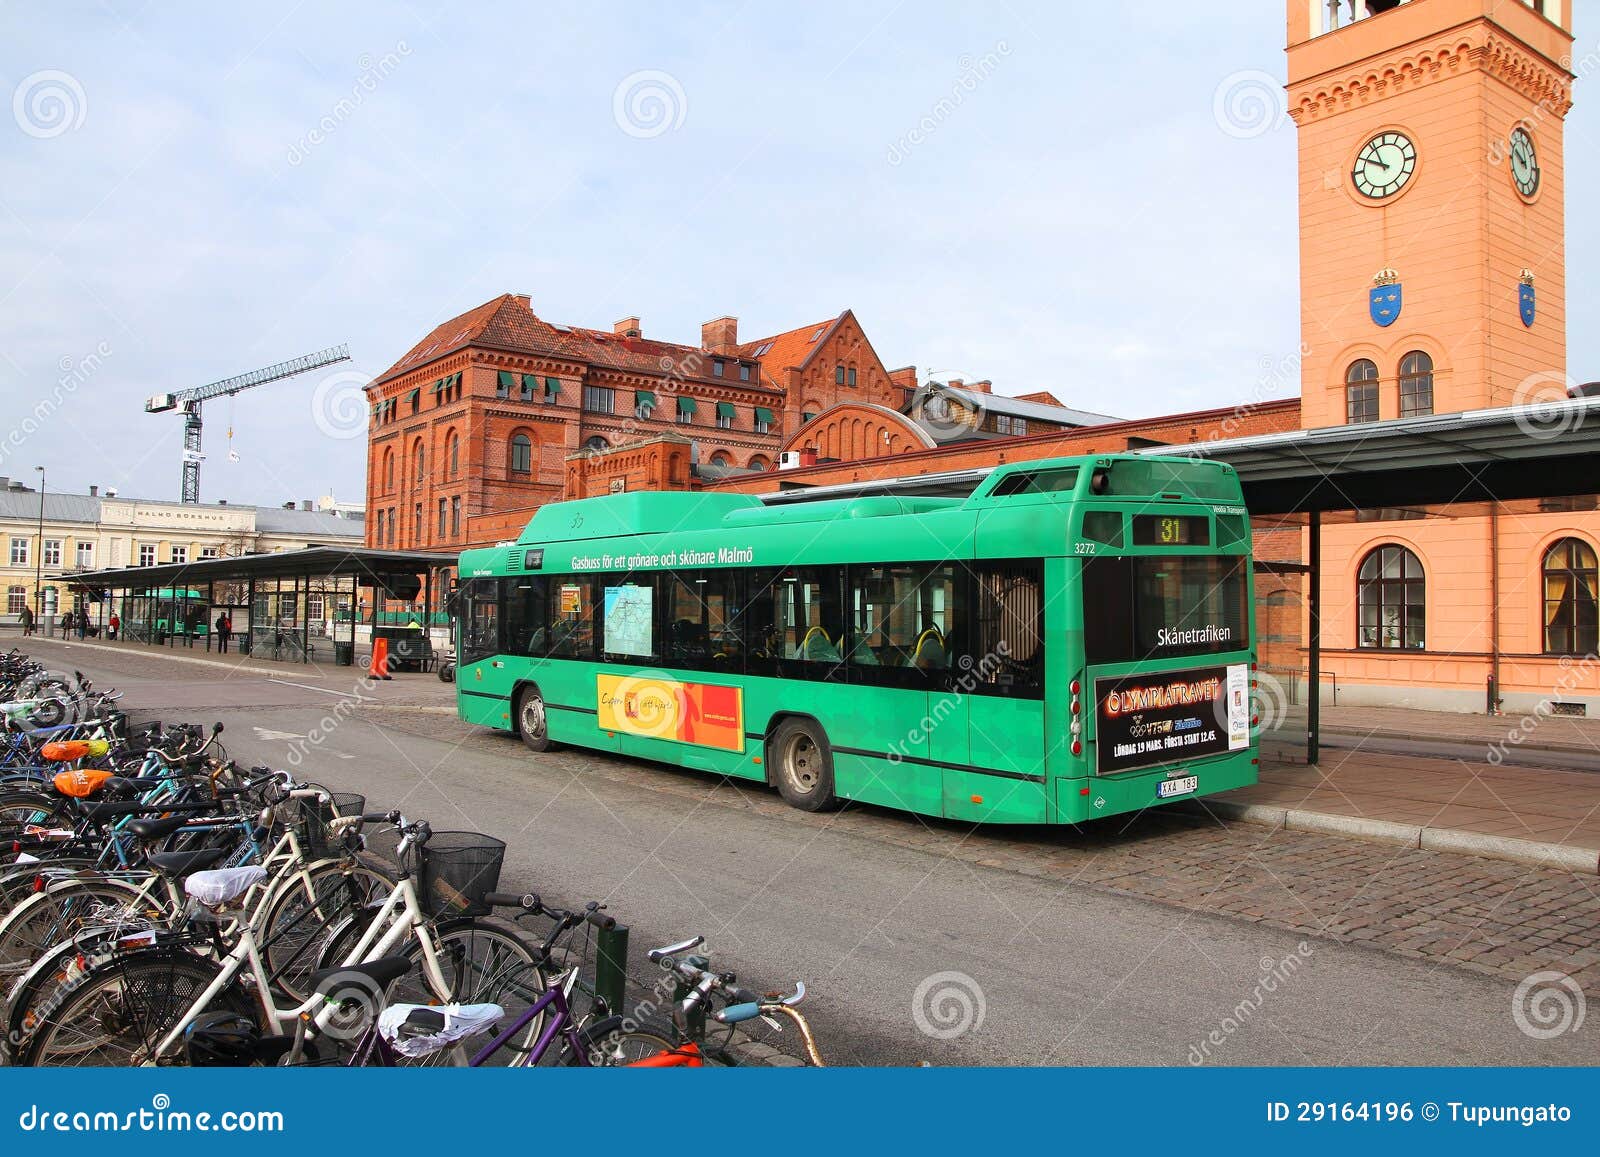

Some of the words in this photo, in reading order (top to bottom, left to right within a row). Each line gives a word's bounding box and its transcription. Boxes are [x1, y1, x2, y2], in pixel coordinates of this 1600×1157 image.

[1160, 518, 1180, 542] 31
[571, 556, 600, 570] Gasbuss
[602, 554, 613, 568] för
[614, 554, 626, 568] ett
[628, 552, 658, 570] grönare
[661, 550, 677, 566] och
[679, 550, 715, 565] skönare
[718, 546, 753, 563] Malmö
[1074, 543, 1095, 554] 3272
[1157, 626, 1231, 646] Skånetrafiken
[1108, 679, 1219, 712] OLYMPIATRAVET
[1113, 743, 1137, 757] LÖRDAG
[1138, 742, 1145, 753] 19
[1146, 740, 1163, 752] MARS.
[1164, 735, 1183, 749] FÖRSTA
[1184, 733, 1200, 745] START
[1163, 781, 1178, 793] XXA
[1183, 777, 1196, 789] 183
